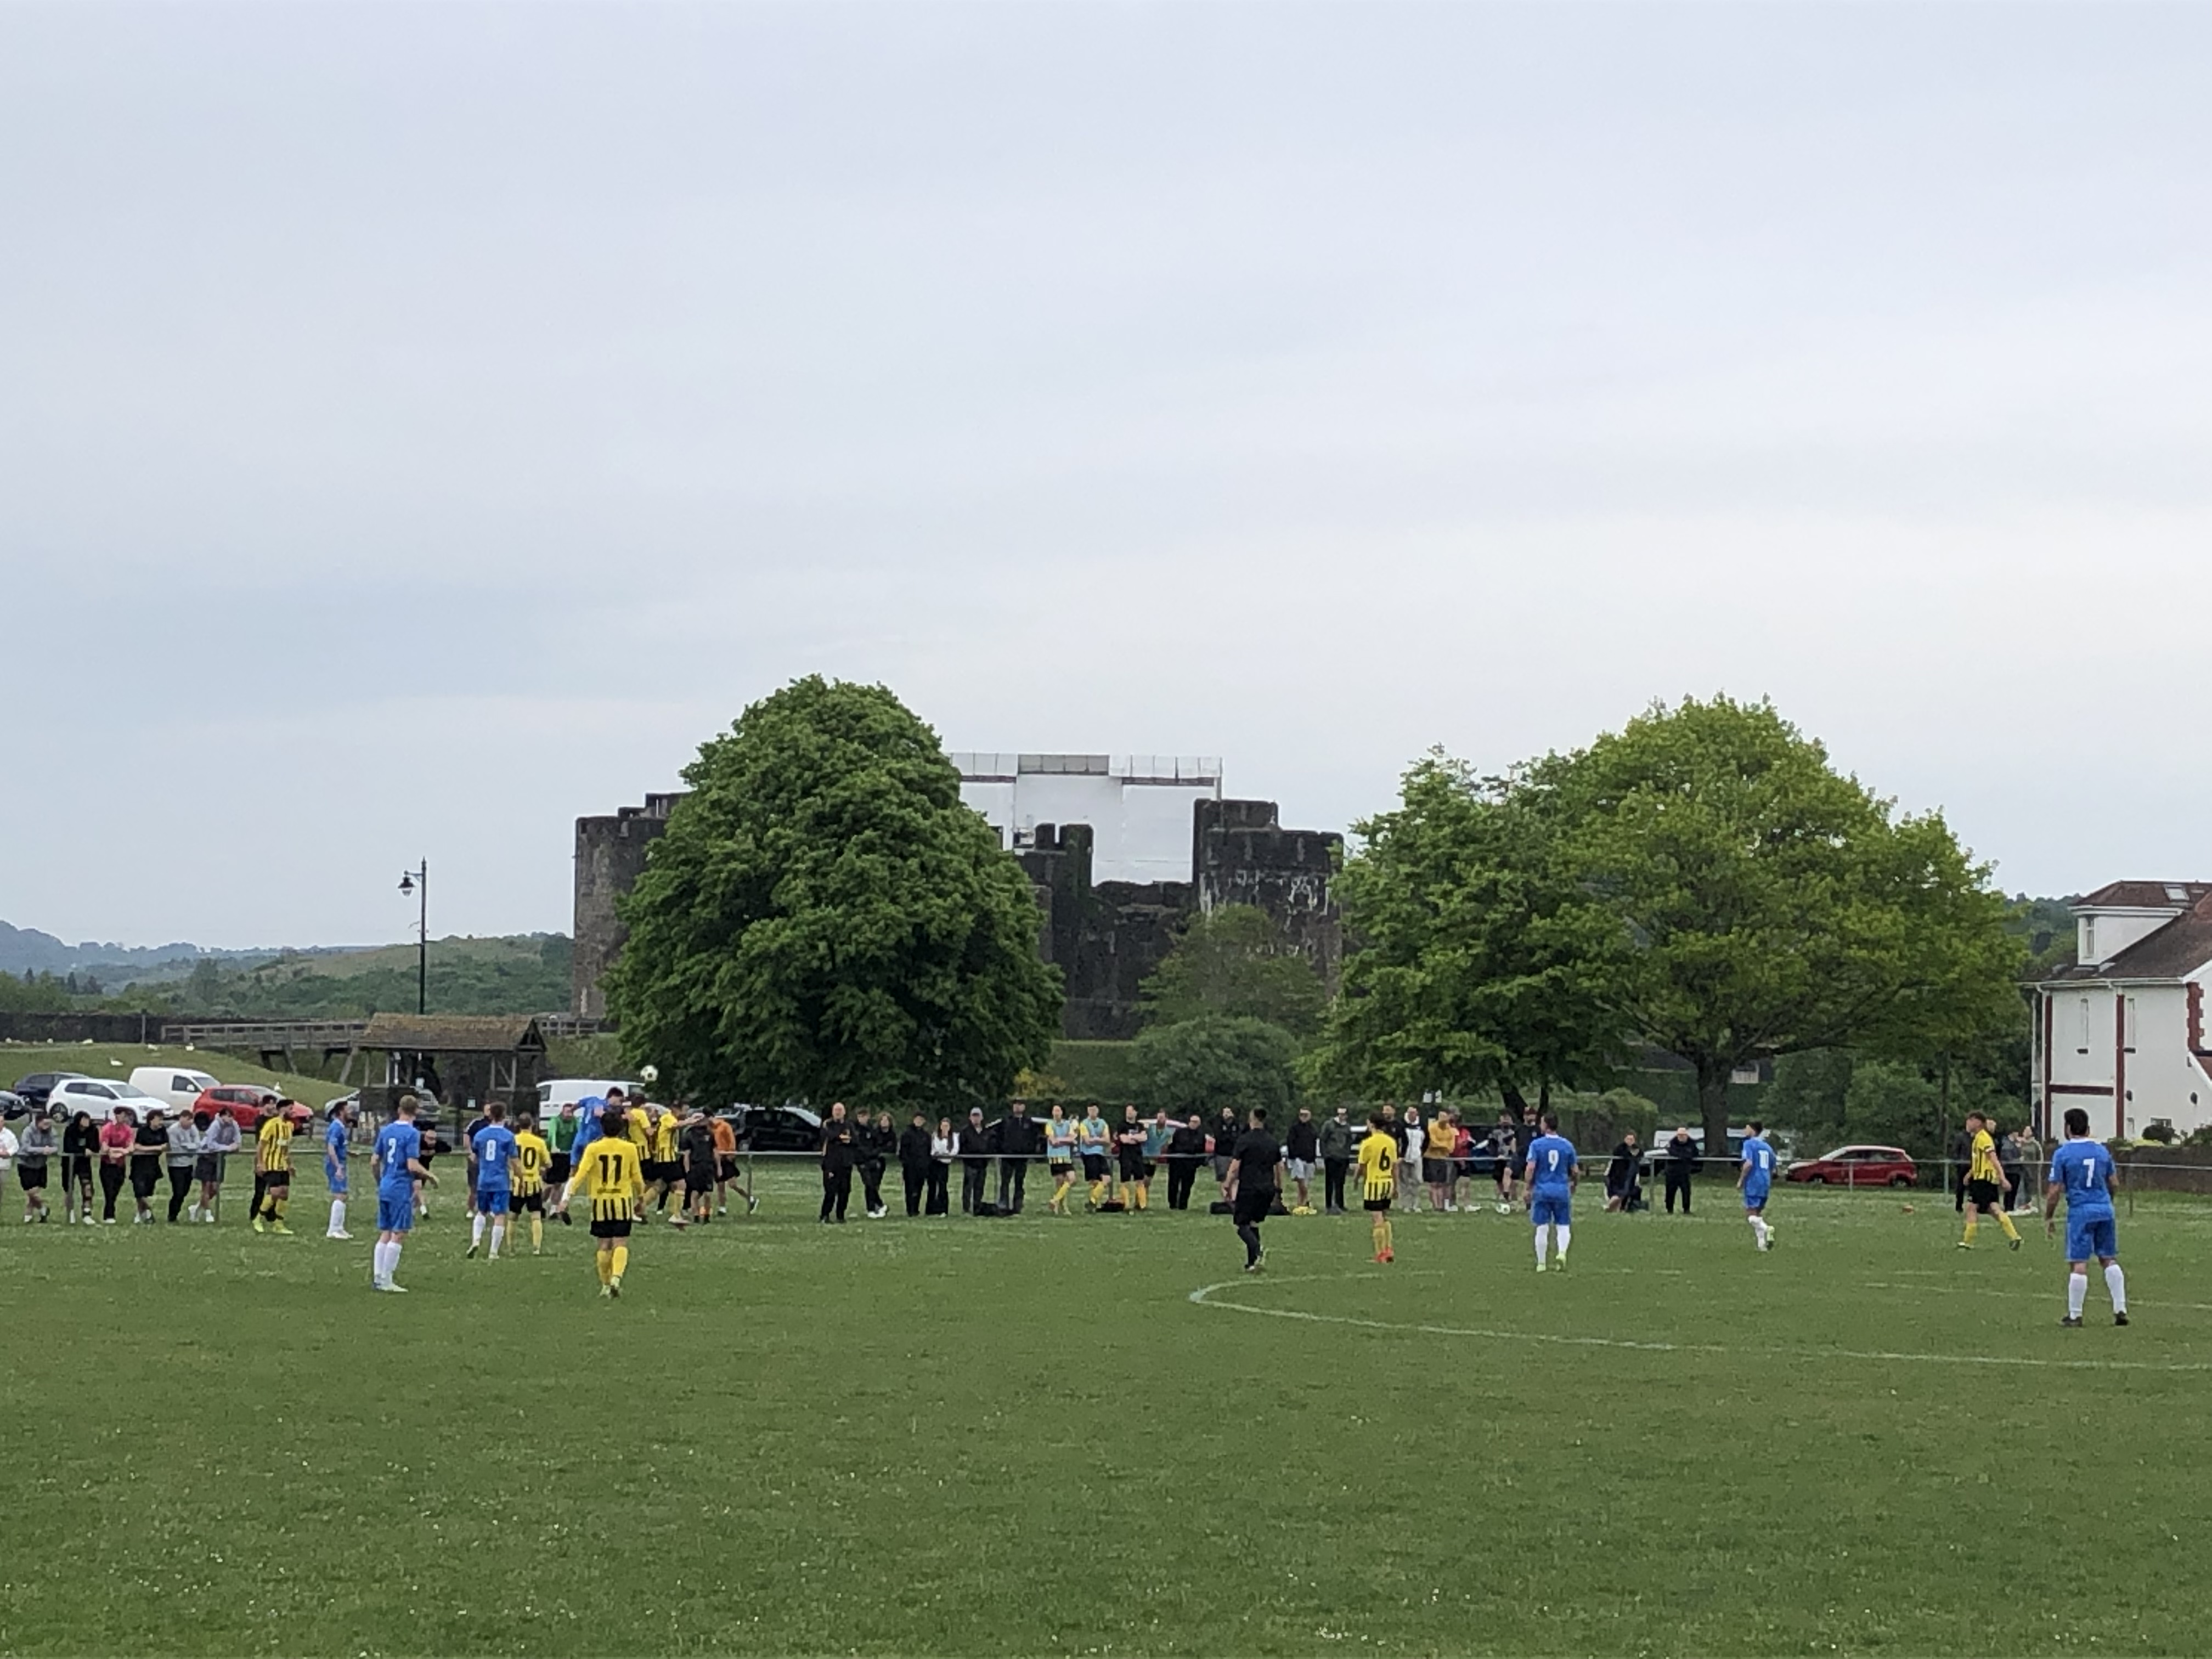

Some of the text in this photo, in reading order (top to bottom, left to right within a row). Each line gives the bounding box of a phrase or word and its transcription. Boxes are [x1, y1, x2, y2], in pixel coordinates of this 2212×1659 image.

[387, 1138, 397, 1164] 2
[486, 1139, 496, 1161] 8
[1379, 1147, 1390, 1171] 6
[1548, 1149, 1559, 1171] 9
[599, 1154, 622, 1185] 11
[2083, 1158, 2095, 1188] 7
